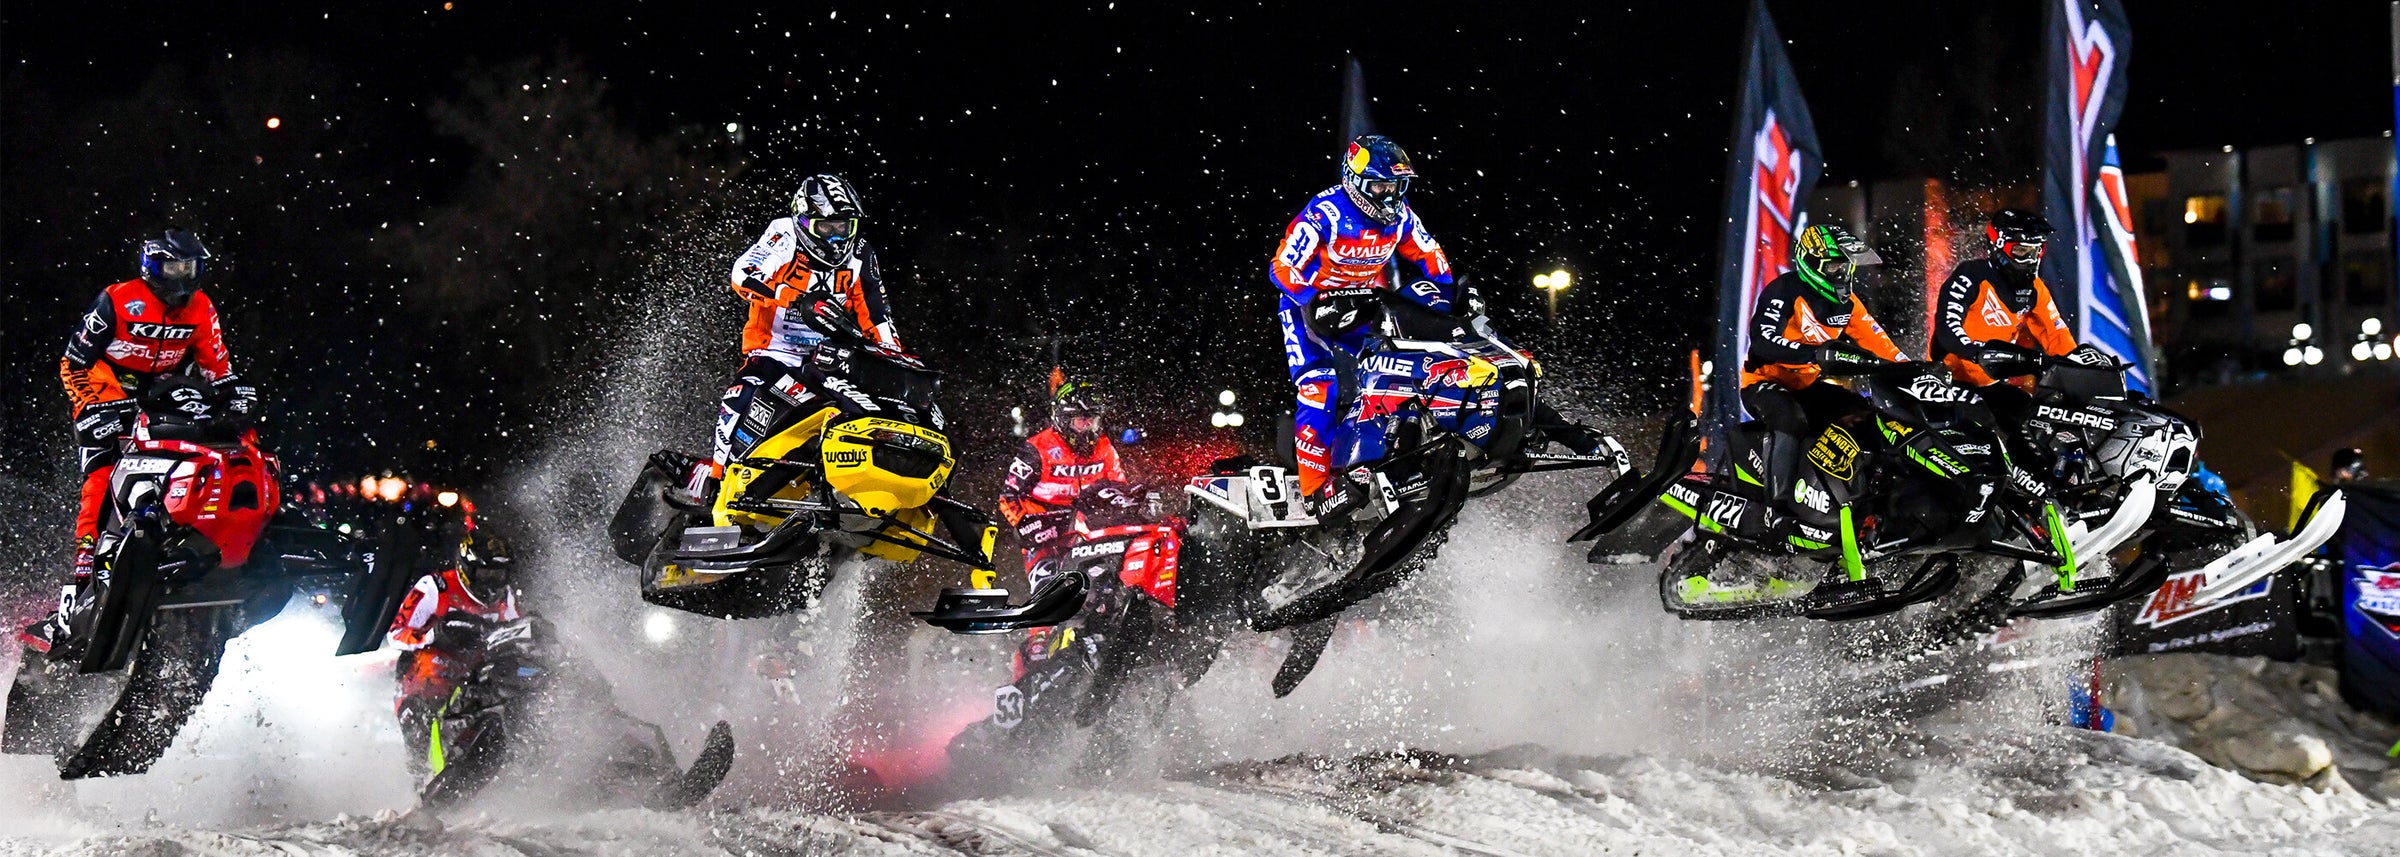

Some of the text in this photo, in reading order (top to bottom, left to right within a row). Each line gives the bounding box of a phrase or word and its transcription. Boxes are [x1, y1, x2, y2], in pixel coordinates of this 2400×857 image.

[1949, 274, 1973, 300] FLY
[1337, 309, 1359, 329] 3
[1278, 308, 1306, 368] FXR
[2036, 405, 2115, 431] POLARIS
[1258, 468, 1281, 501] 3
[1382, 485, 1397, 503] 3
[1706, 492, 1747, 529] 727
[1071, 541, 1125, 559] POLARIS
[996, 691, 1023, 723] 53
